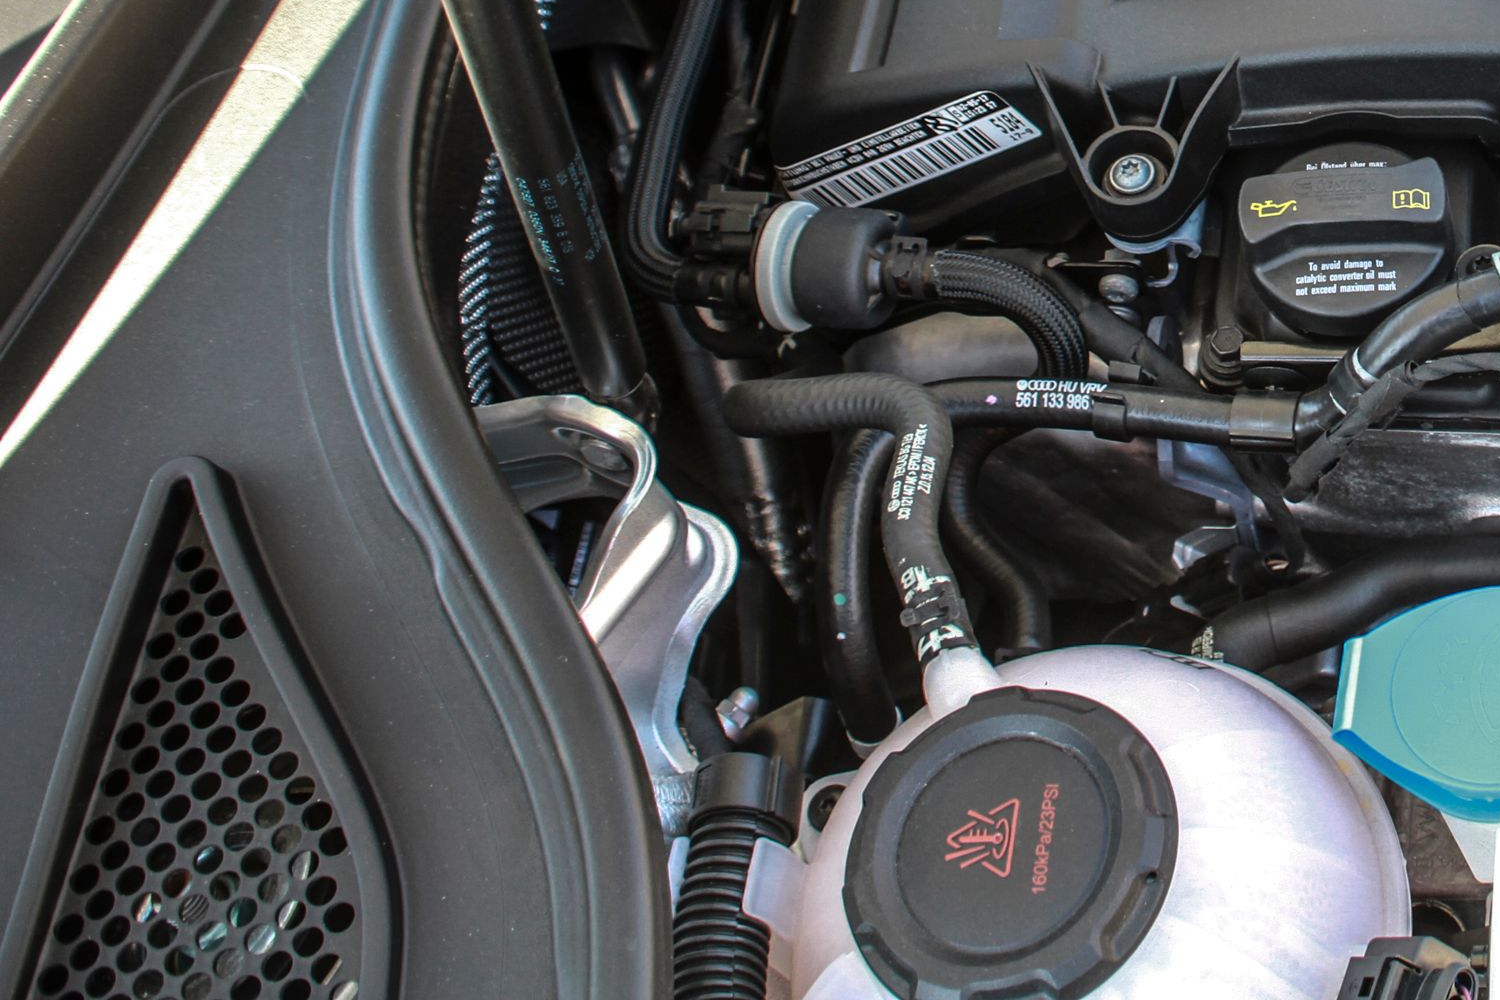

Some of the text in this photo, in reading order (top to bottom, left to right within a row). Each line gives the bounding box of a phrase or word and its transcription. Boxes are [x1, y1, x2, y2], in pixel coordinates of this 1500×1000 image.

[989, 111, 1025, 135] 5184
[1308, 259, 1384, 271] To avoid damage to
[1296, 270, 1397, 284] catalytic converter oil must
[1296, 281, 1397, 296] not exceed maximum mark
[1058, 381, 1078, 392] HU
[1015, 392, 1089, 410] 561 133 986
[1031, 783, 1059, 895] 160kPa/23PSI
